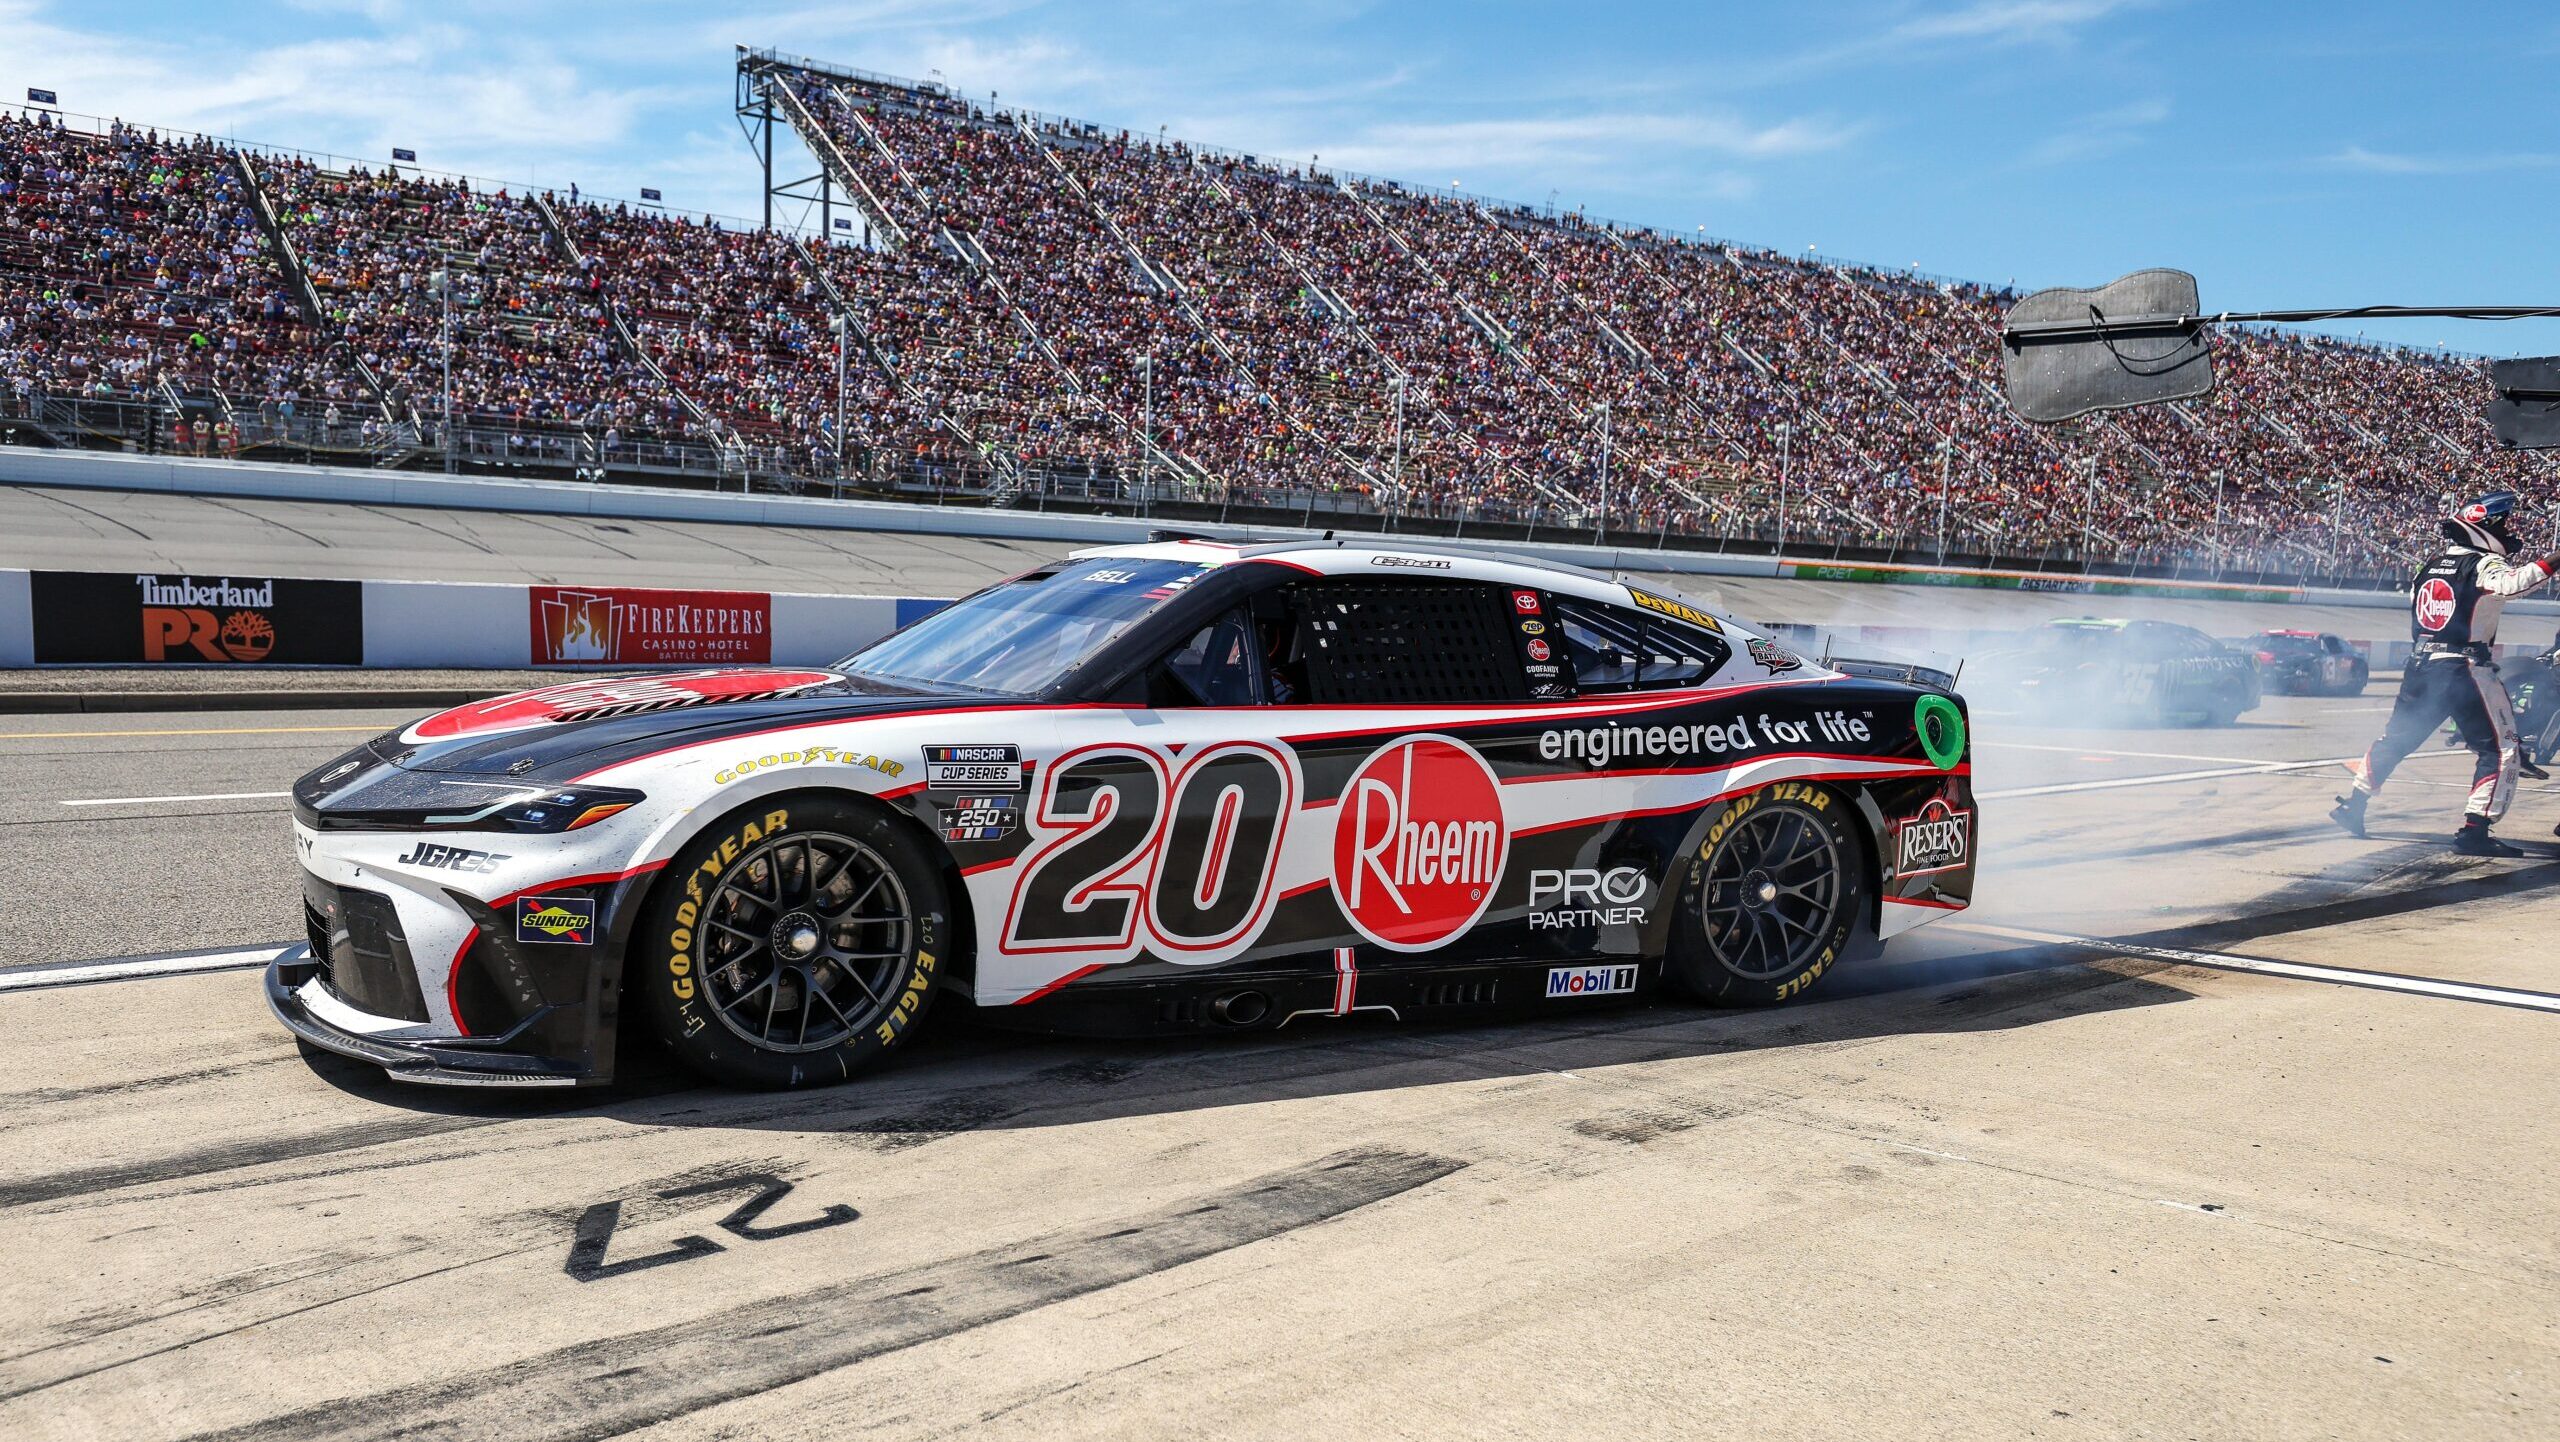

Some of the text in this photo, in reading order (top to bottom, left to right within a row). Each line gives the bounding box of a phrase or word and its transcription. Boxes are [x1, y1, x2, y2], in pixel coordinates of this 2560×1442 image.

[1082, 570, 1138, 584] BELL
[1817, 567, 1856, 580] POET
[1925, 573, 1960, 584] POET
[136, 575, 273, 608] Timberland
[2418, 579, 2453, 623] Rheem
[642, 639, 750, 651] CASINO HOTEL
[658, 651, 696, 660] BATTLE
[1539, 715, 1757, 766] engineered
[1757, 713, 1812, 745] for
[955, 748, 1005, 761] NASCAR
[941, 766, 1009, 780] CUP SERIES
[957, 809, 1000, 827] 250
[1349, 742, 1497, 915] Rheem
[1000, 739, 1298, 955] 20
[1901, 816, 1964, 870] RESER'S
[1528, 866, 1647, 907] PRO
[524, 914, 587, 928] SUNOCO
[1528, 906, 1646, 930] PARTNER
[1549, 968, 1629, 993] Mobil 1
[1775, 946, 1835, 1001] EAGLE
[875, 949, 936, 1047] EAGLE
